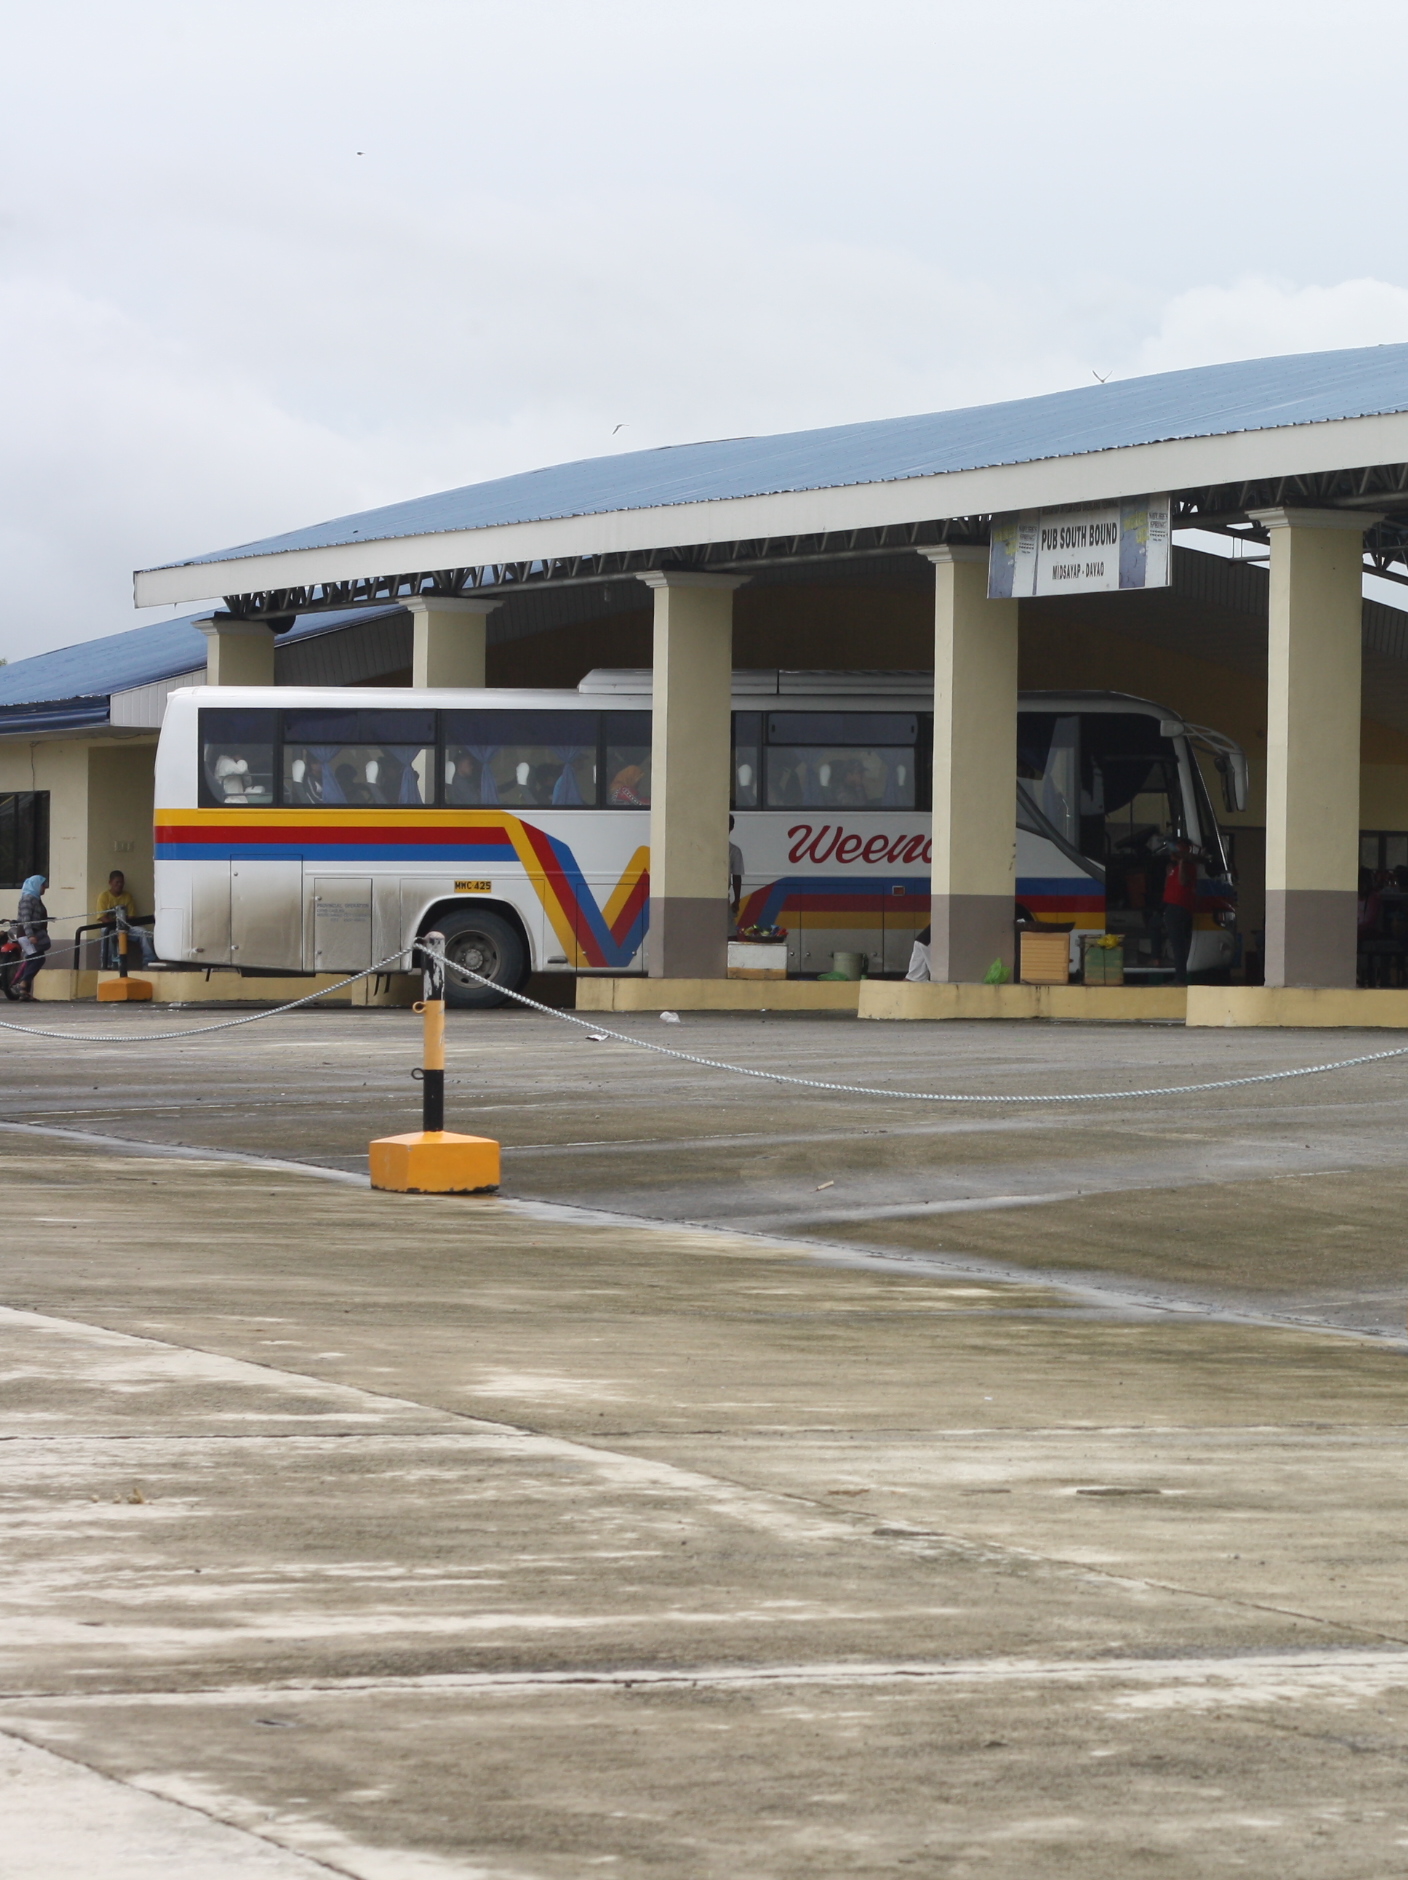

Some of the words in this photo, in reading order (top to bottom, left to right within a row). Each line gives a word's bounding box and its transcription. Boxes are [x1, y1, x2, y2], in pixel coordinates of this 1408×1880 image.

[1041, 528, 1058, 551] PUB
[1060, 525, 1087, 549] SOUTH
[1089, 522, 1118, 547] BOUND
[1052, 563, 1081, 580] MIDSAYAP
[1086, 561, 1104, 578] DAVAO
[474, 881, 491, 890] 425
